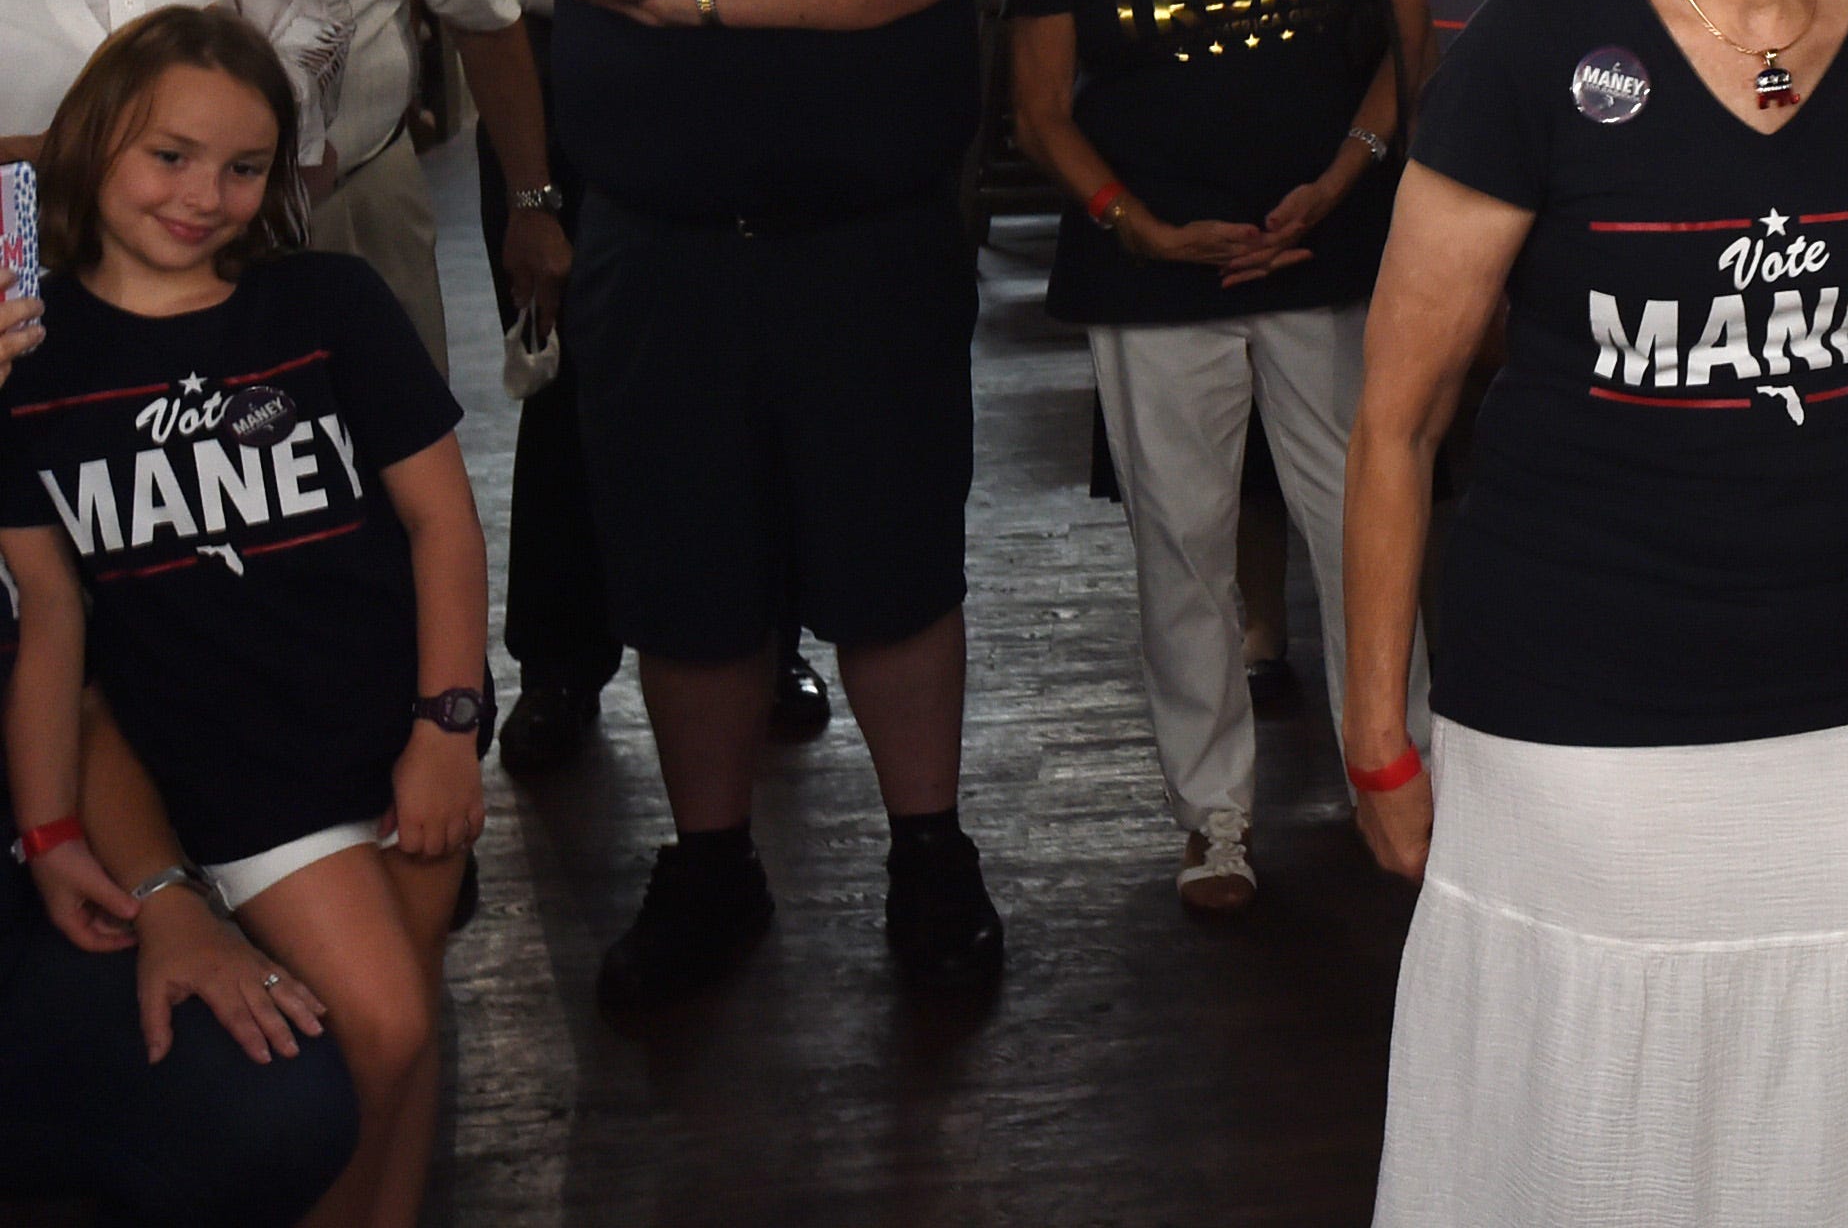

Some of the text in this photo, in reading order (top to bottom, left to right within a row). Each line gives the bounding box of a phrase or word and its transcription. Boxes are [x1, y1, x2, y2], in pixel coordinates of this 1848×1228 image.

[1582, 64, 1646, 97] MANEY
[1718, 235, 1831, 291] Vote
[135, 390, 233, 444] Vot
[231, 396, 284, 436] MANEY
[37, 412, 364, 556] MANEY
